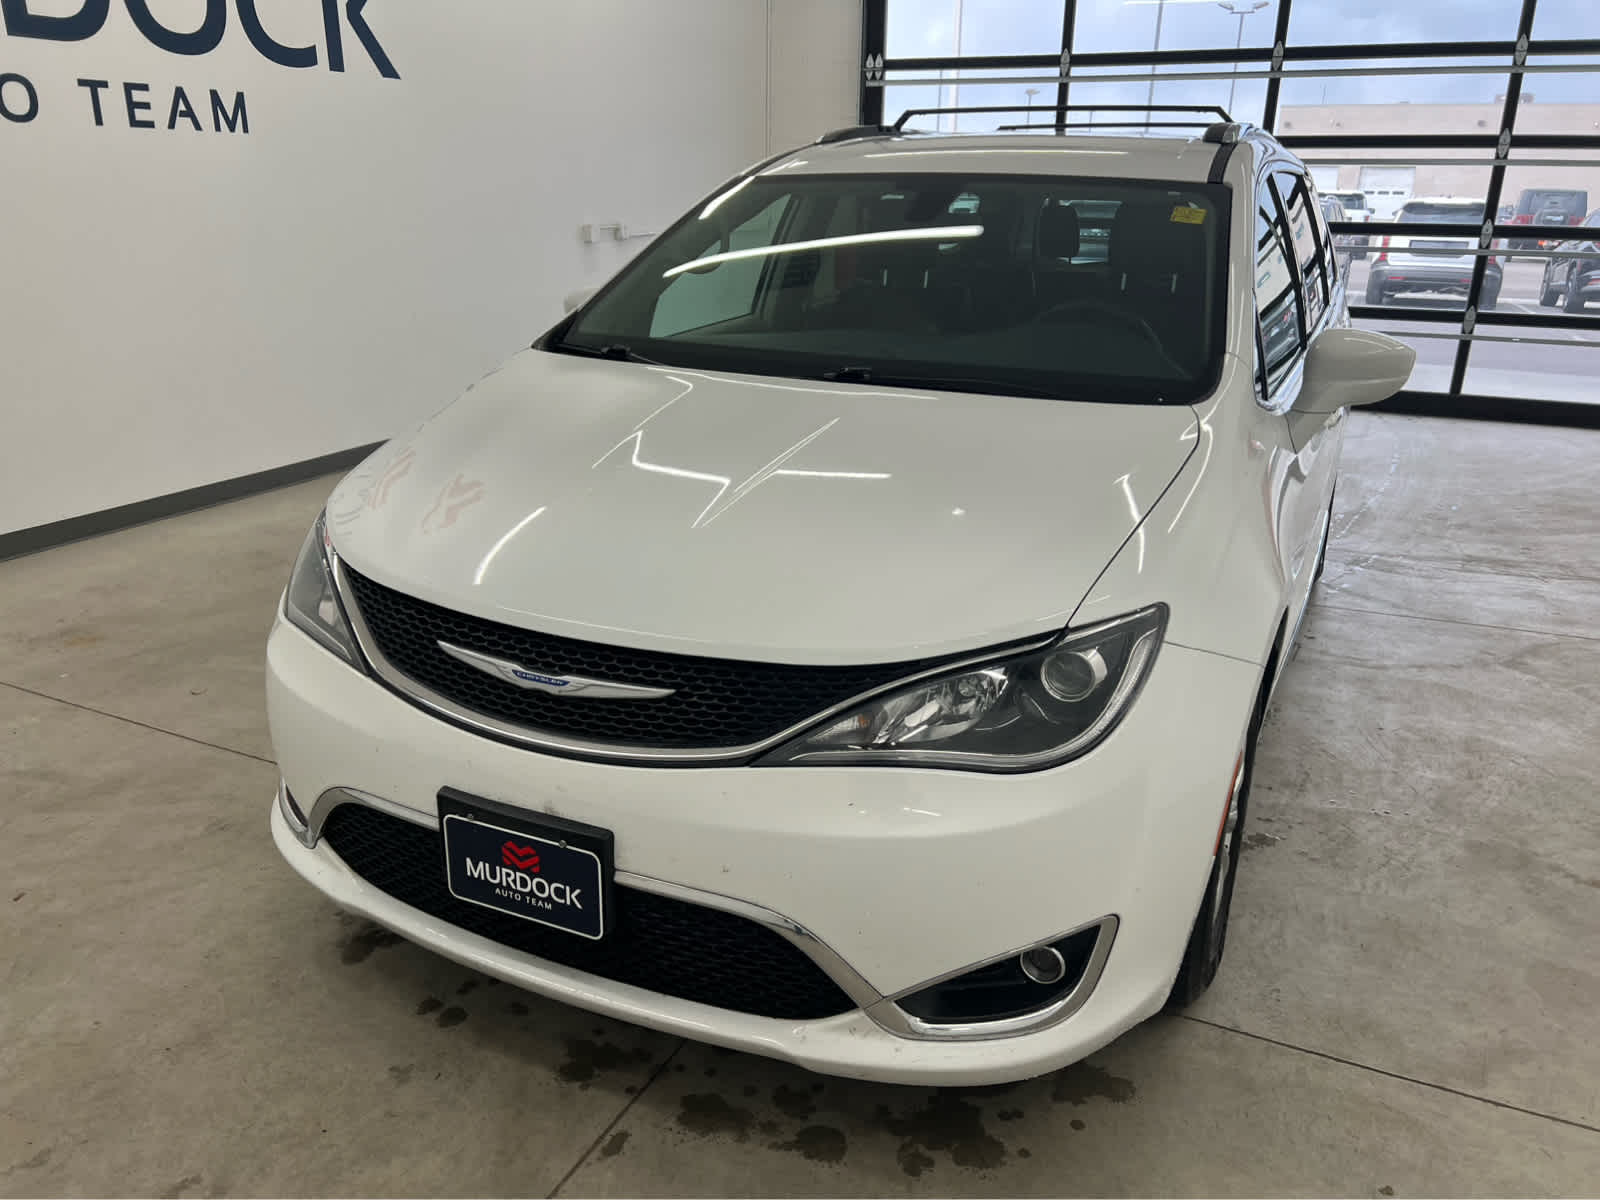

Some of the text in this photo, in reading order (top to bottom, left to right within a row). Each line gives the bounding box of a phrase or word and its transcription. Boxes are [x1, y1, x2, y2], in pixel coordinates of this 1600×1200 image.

[77, 78, 249, 134] TEAM
[465, 857, 583, 910] MURDOCK
[495, 888, 552, 910] AUTO TEAM
